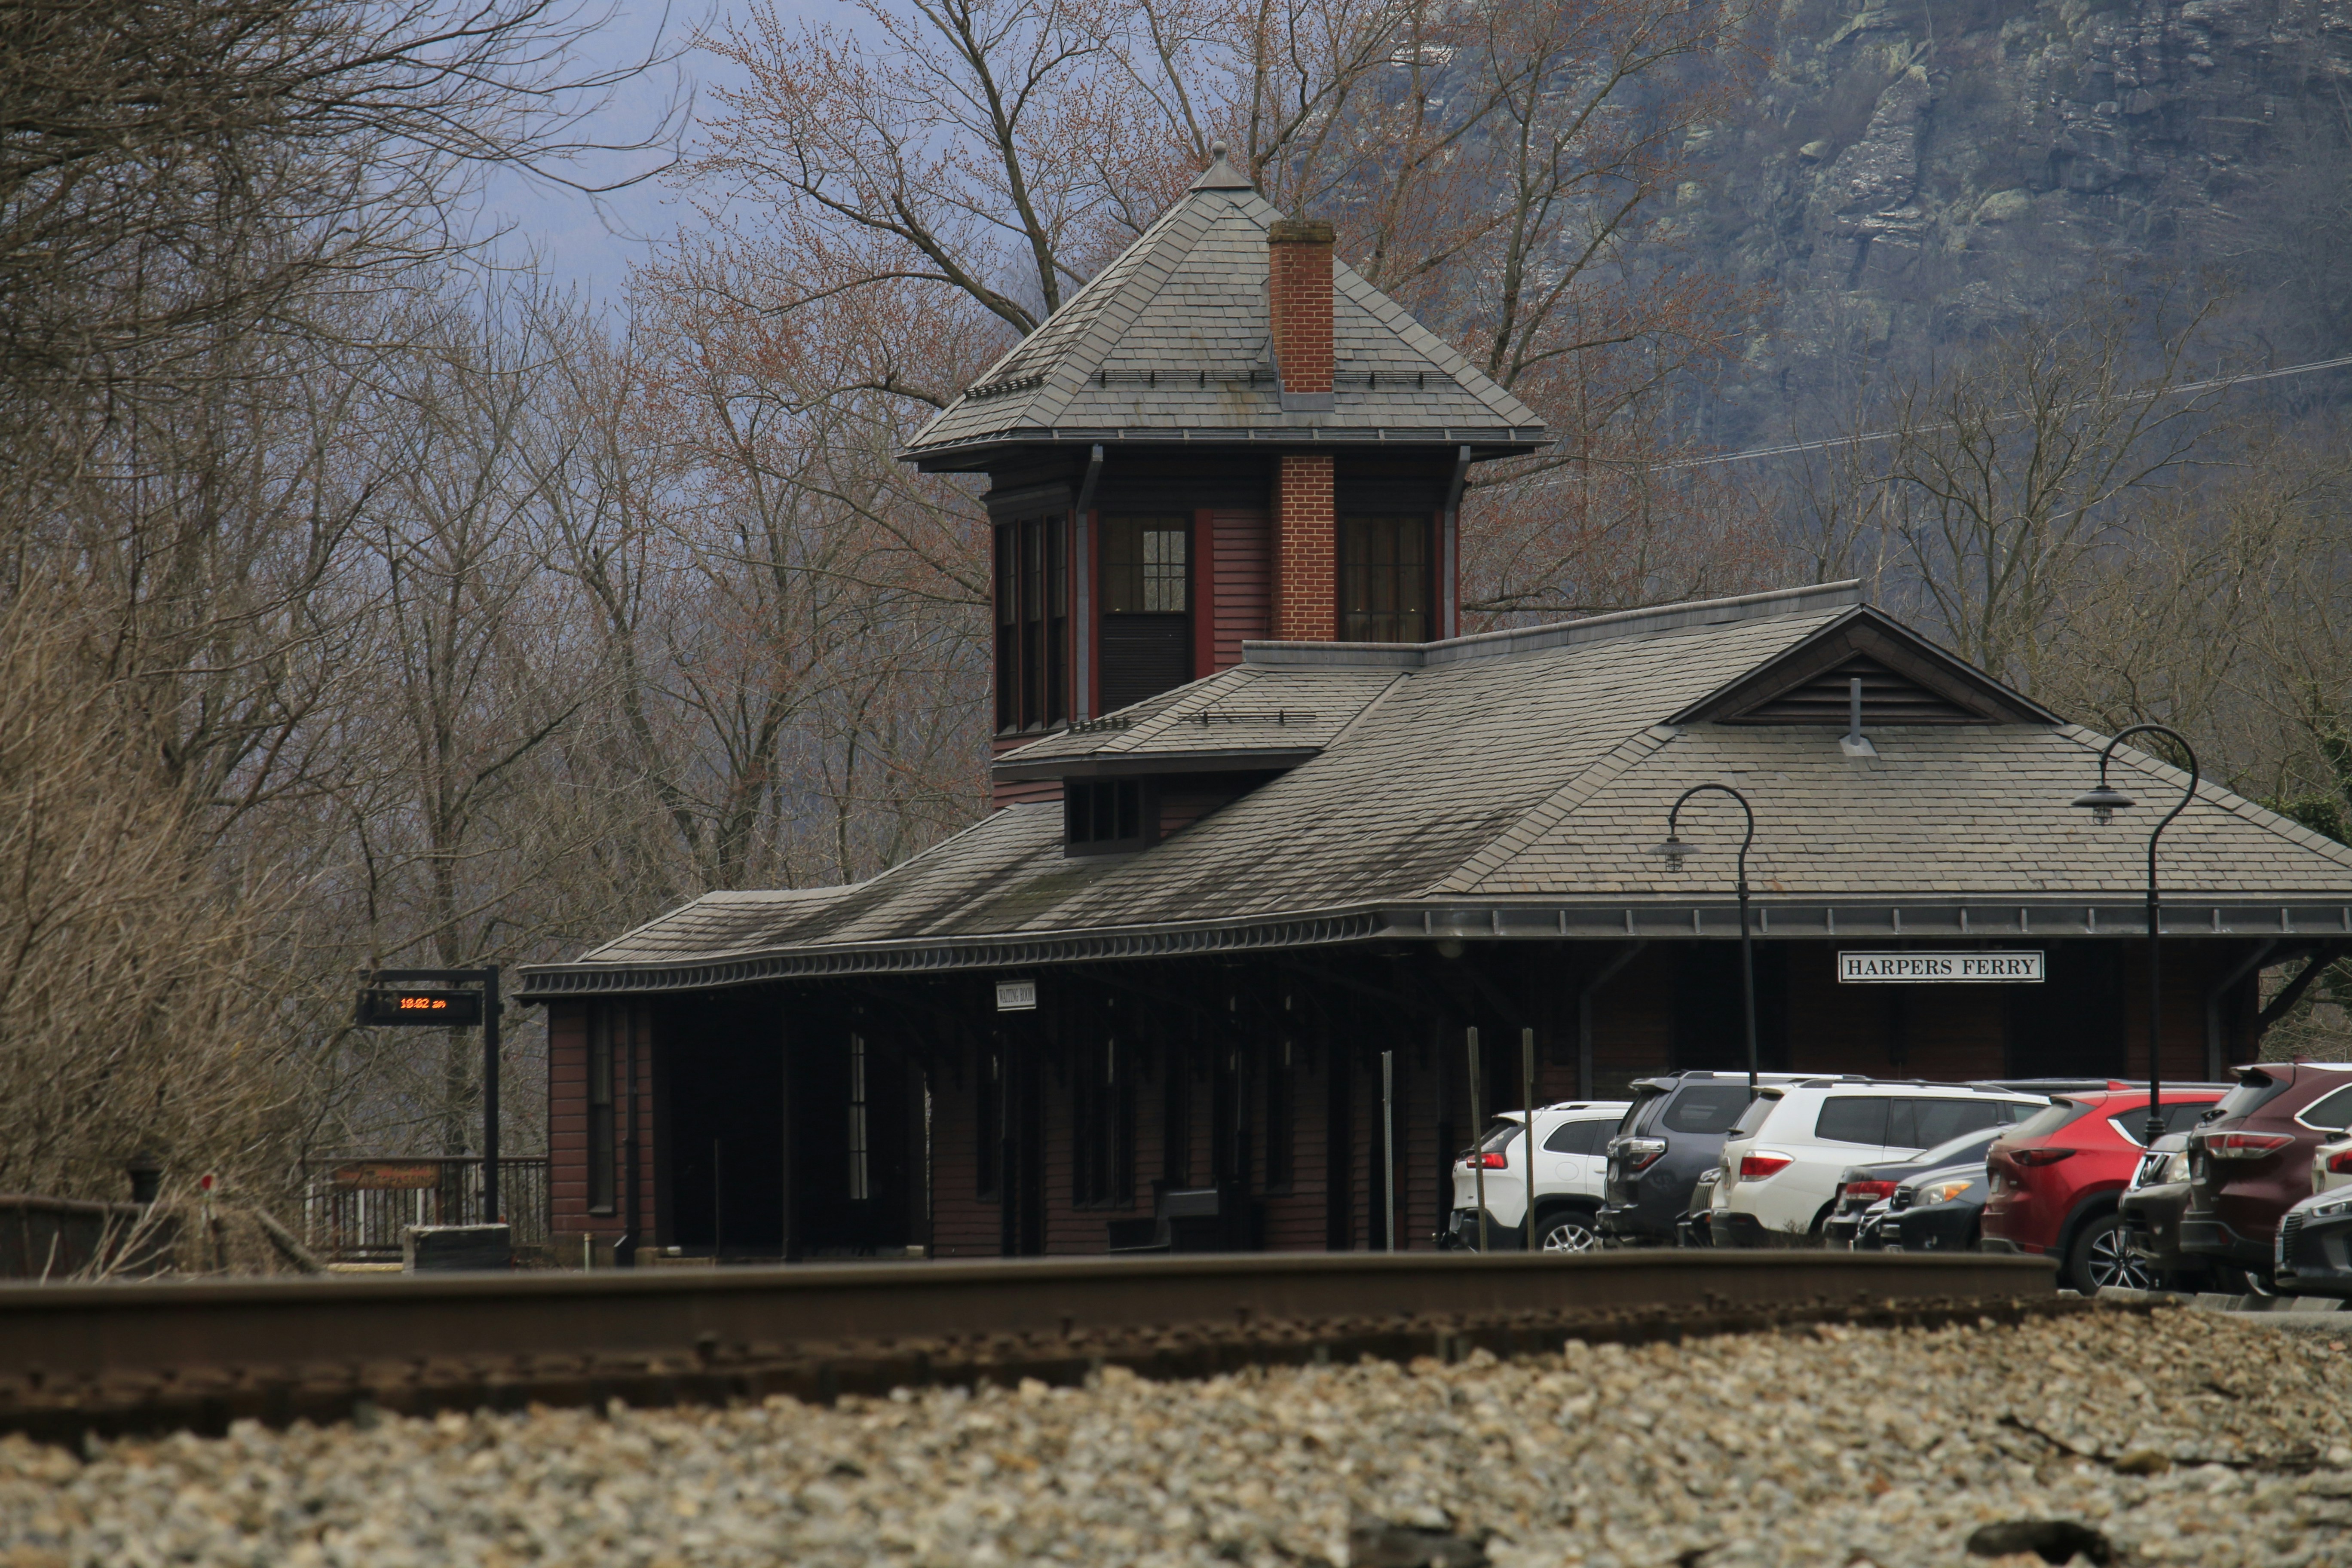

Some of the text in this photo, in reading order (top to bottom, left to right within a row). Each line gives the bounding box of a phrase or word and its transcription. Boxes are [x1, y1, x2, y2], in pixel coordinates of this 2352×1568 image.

[1847, 959, 2036, 975] HARPERS FERRY
[998, 987, 1033, 1003] WAITING ROOM
